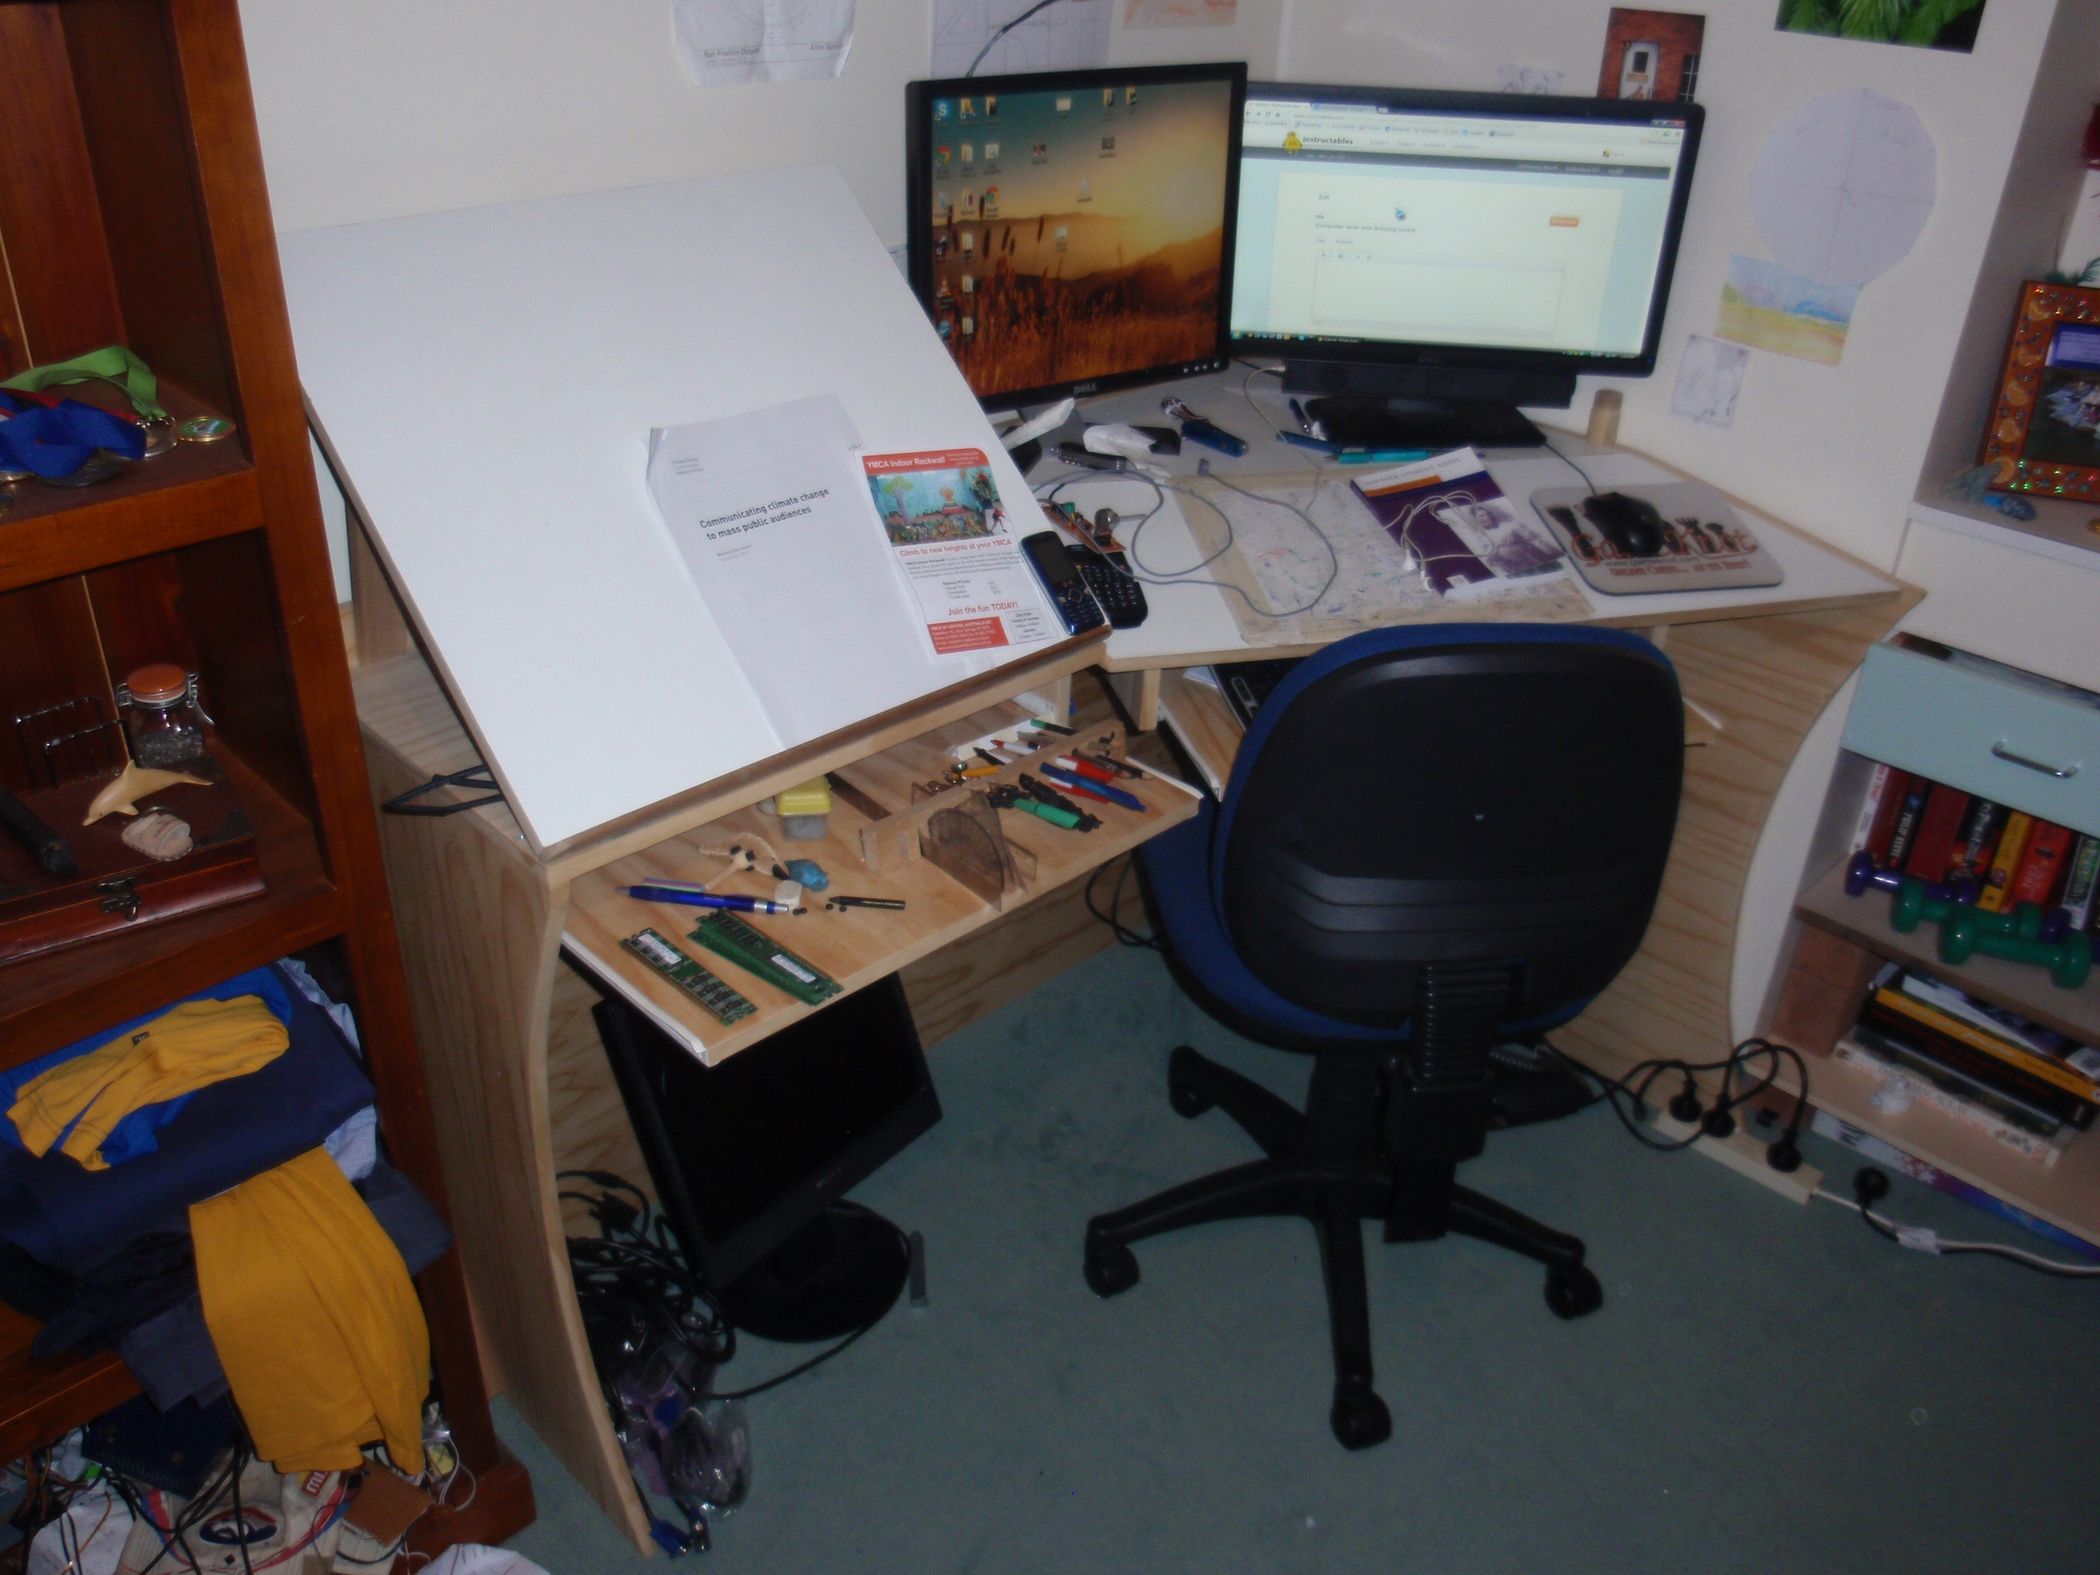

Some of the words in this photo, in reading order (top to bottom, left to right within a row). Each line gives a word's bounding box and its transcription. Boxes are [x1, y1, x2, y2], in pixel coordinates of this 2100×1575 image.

[1302, 136, 1354, 145] instructables
[867, 460, 890, 469] YMCA
[891, 458, 913, 467] Indoor
[914, 456, 945, 465] Rockwall
[700, 504, 768, 529] Communicating
[768, 497, 799, 511] climate
[800, 488, 830, 502] change
[706, 532, 717, 541] to
[718, 525, 741, 538] mass
[742, 517, 769, 533] public
[770, 506, 812, 523] audiences
[900, 549, 920, 557] Climb
[976, 542, 992, 550] your
[948, 607, 963, 617] Join
[964, 605, 977, 613] the
[978, 604, 990, 612] fun
[991, 601, 1019, 610] TODAY!
